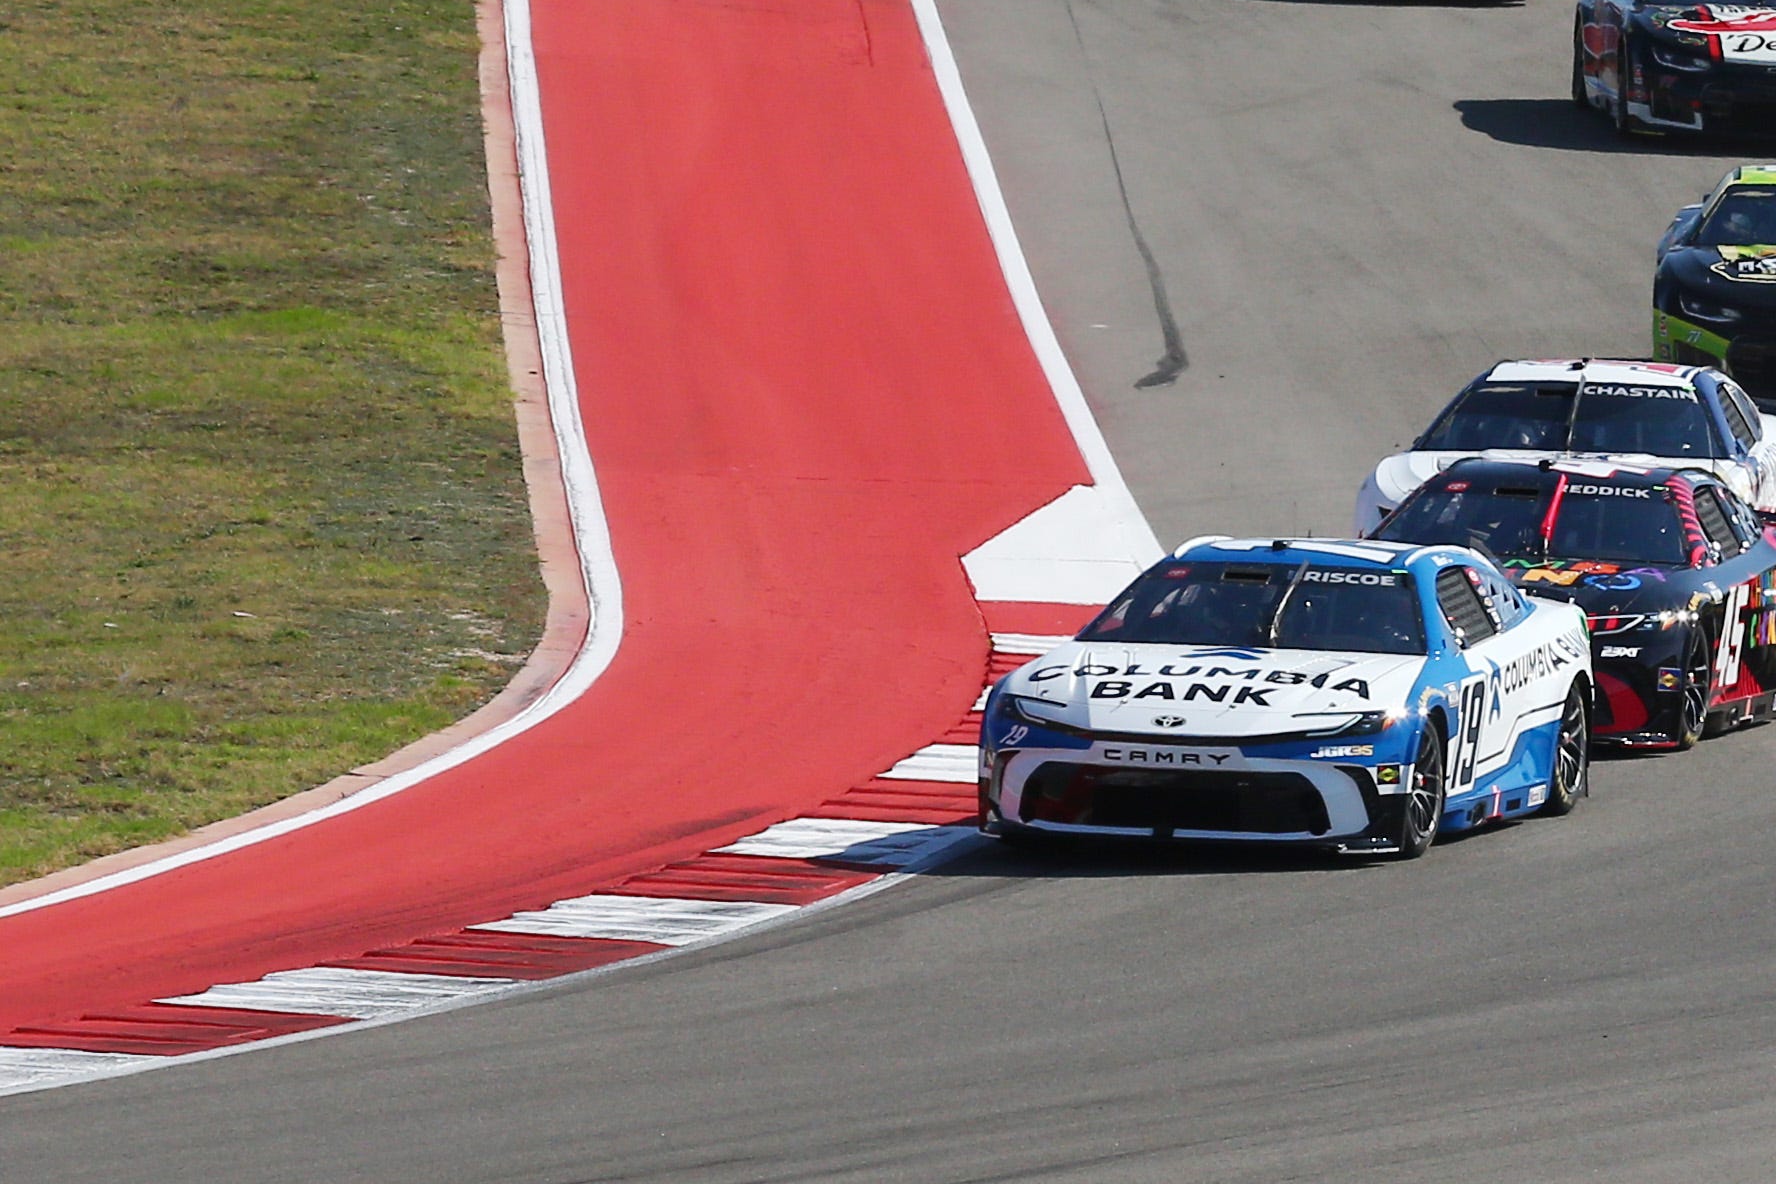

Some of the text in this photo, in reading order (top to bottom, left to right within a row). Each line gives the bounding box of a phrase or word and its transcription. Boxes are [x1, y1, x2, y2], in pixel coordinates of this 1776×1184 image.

[1582, 384, 1698, 404] CHASTAIN
[1562, 483, 1650, 499] REDDICK
[1299, 569, 1396, 587] RISCOE
[1503, 641, 1570, 696] COLUMBIA
[1028, 663, 1370, 701] COLUMBIA
[1090, 681, 1279, 707] BANK
[999, 725, 1028, 745] 19
[1103, 748, 1232, 766] CAMRY
